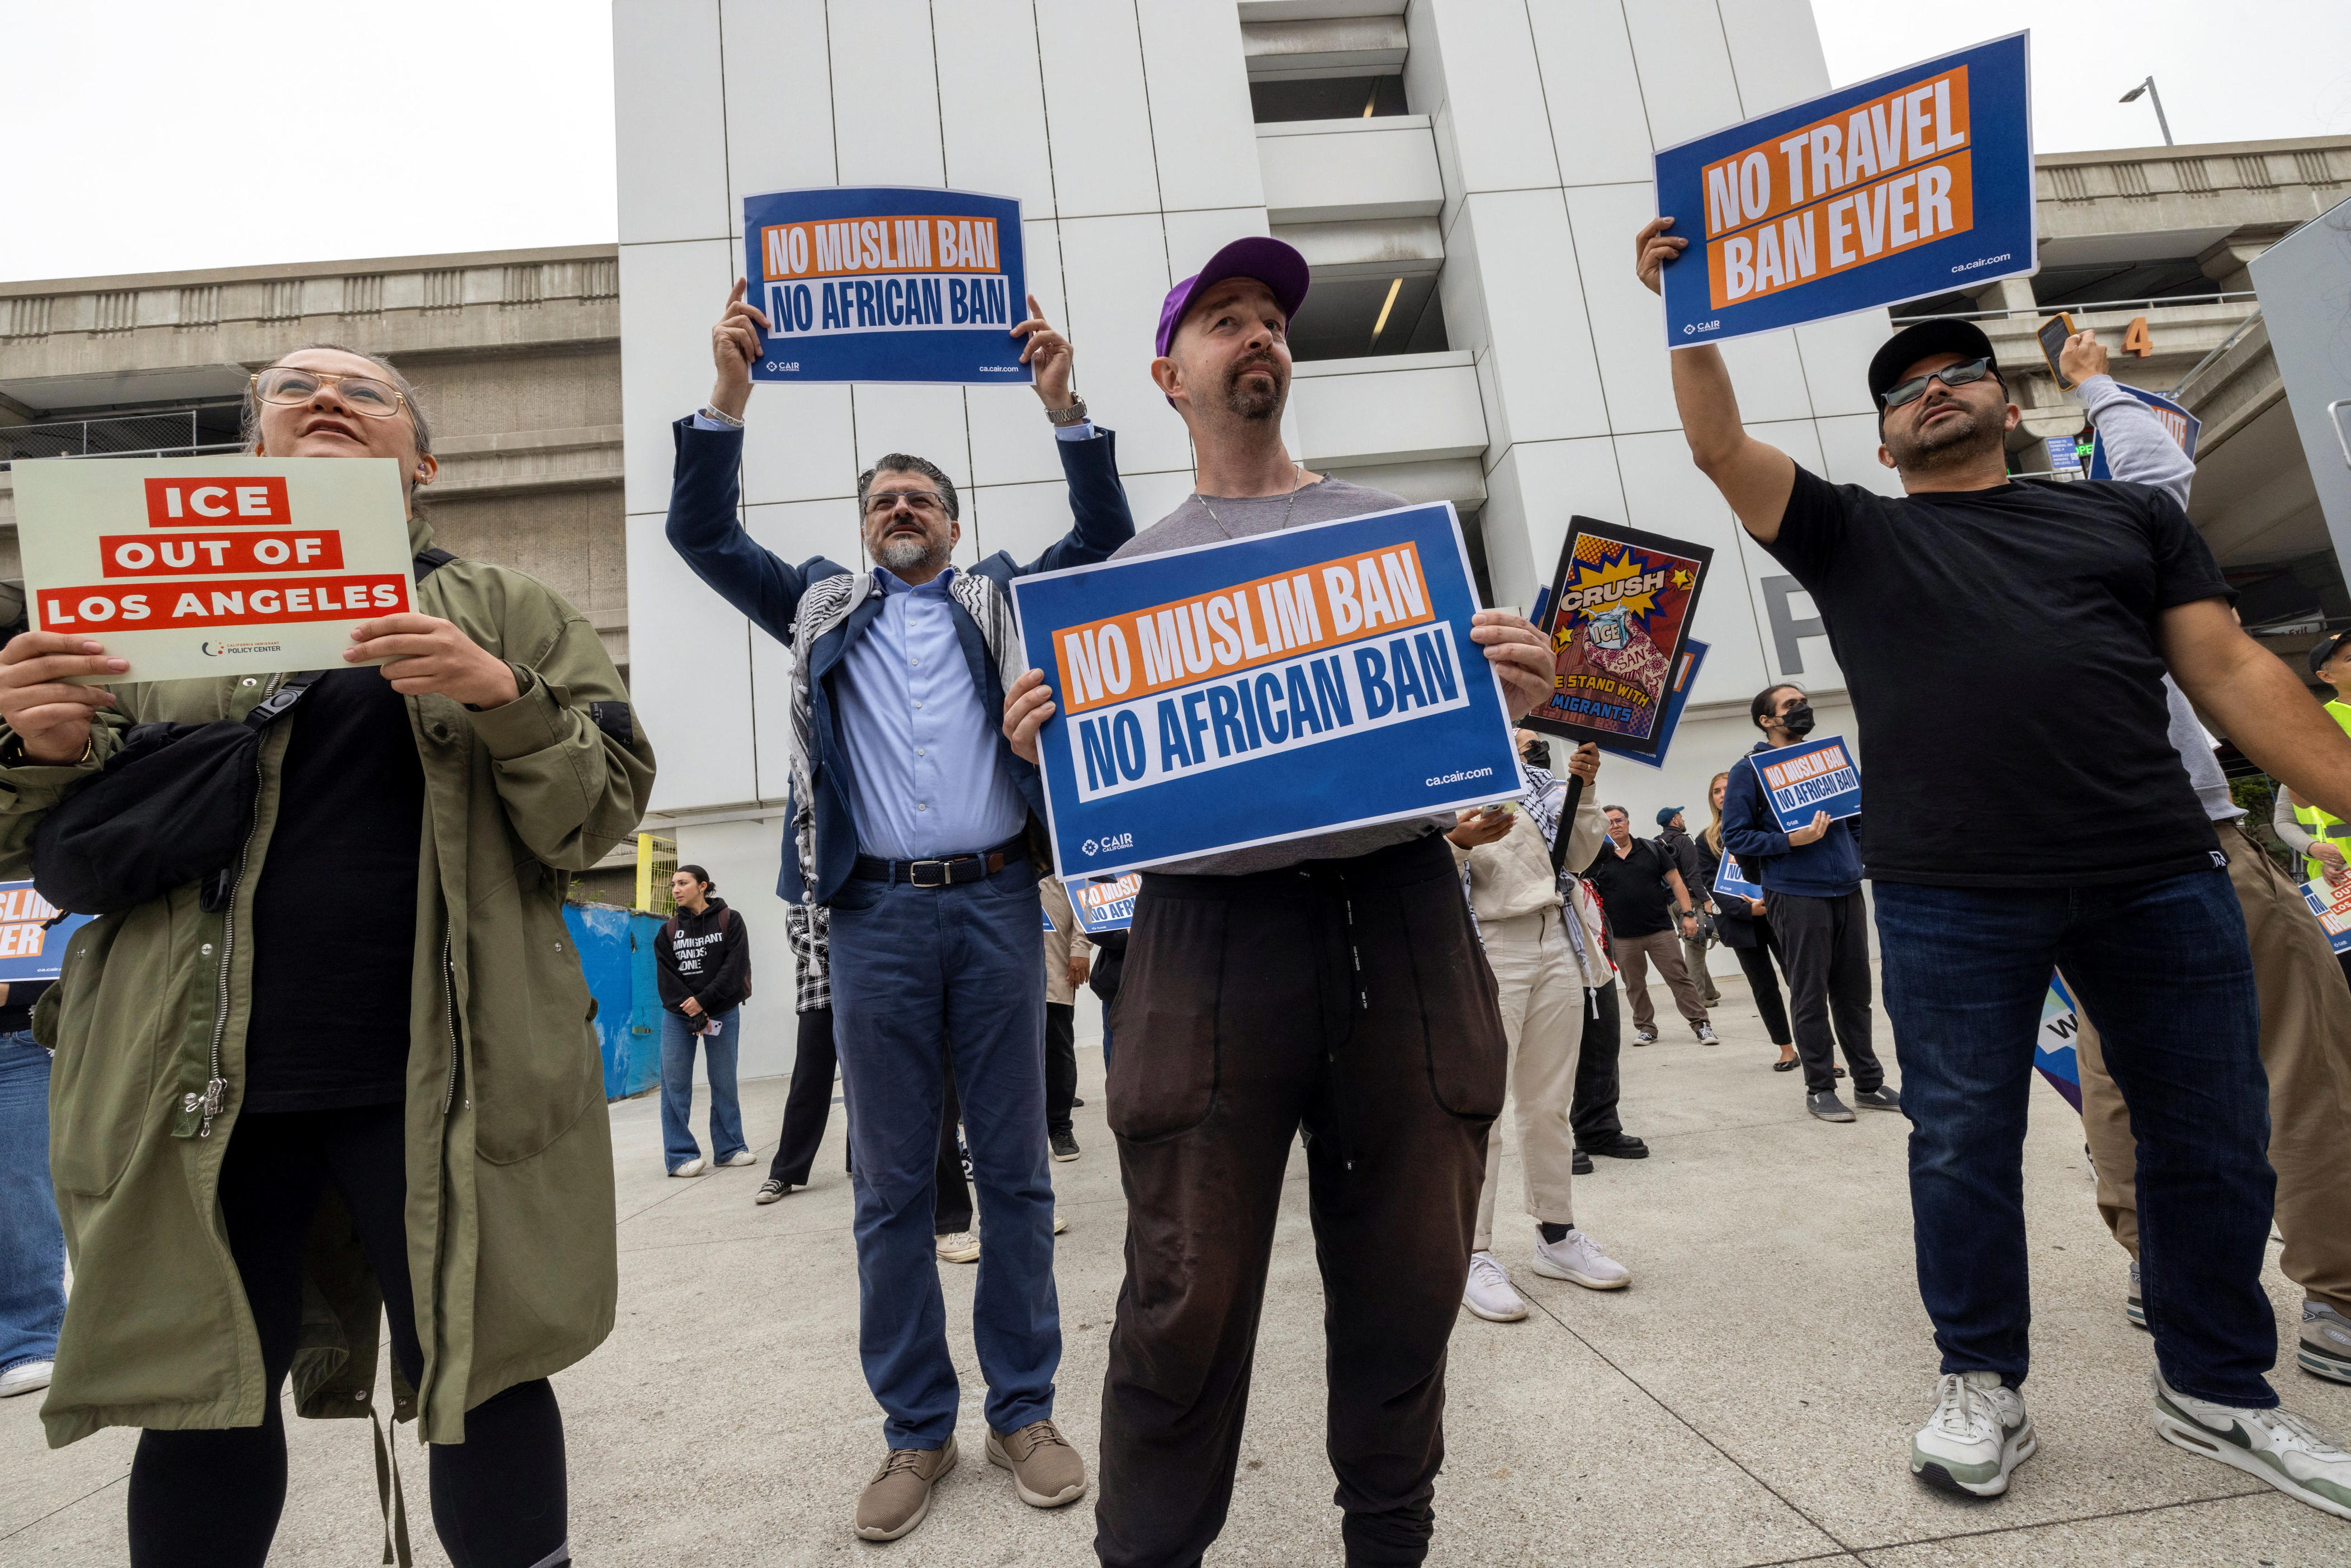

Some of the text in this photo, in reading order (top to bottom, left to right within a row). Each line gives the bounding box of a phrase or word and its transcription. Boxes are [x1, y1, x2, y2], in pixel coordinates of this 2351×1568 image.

[1708, 78, 1964, 234] NO TRAVEL
[768, 220, 996, 276] NO MUSLIM BAN
[1724, 165, 1953, 301] BAN EVER
[1951, 253, 2011, 274] ca.cair.com
[772, 278, 1006, 333] NO AFRICAN BAN
[1697, 320, 1720, 329] CAIR
[2122, 317, 2153, 358] 4
[165, 486, 272, 518] ICE
[115, 538, 321, 569] OUT OF
[47, 584, 399, 625] LOS ANGELES
[1560, 570, 1665, 612] CRUSH
[1064, 549, 1426, 705] NO MUSLIM BAN
[1593, 624, 1620, 644] ICE
[1617, 648, 1647, 671] SAN
[1555, 675, 1649, 708] E STAND WITH
[1079, 629, 1461, 792] NO AFRICAN BAN
[1550, 694, 1633, 723] MIGRANTS
[1426, 766, 1492, 788] ca.cair.com
[1766, 747, 1846, 788] NO MUSLIM BAN
[1776, 769, 1856, 810] NO AFRICAN BAN
[1101, 833, 1133, 847] CAIR
[1103, 843, 1133, 852] CALIFORNIA
[1727, 864, 1742, 880] NO
[673, 932, 722, 951] MMIGRANT
